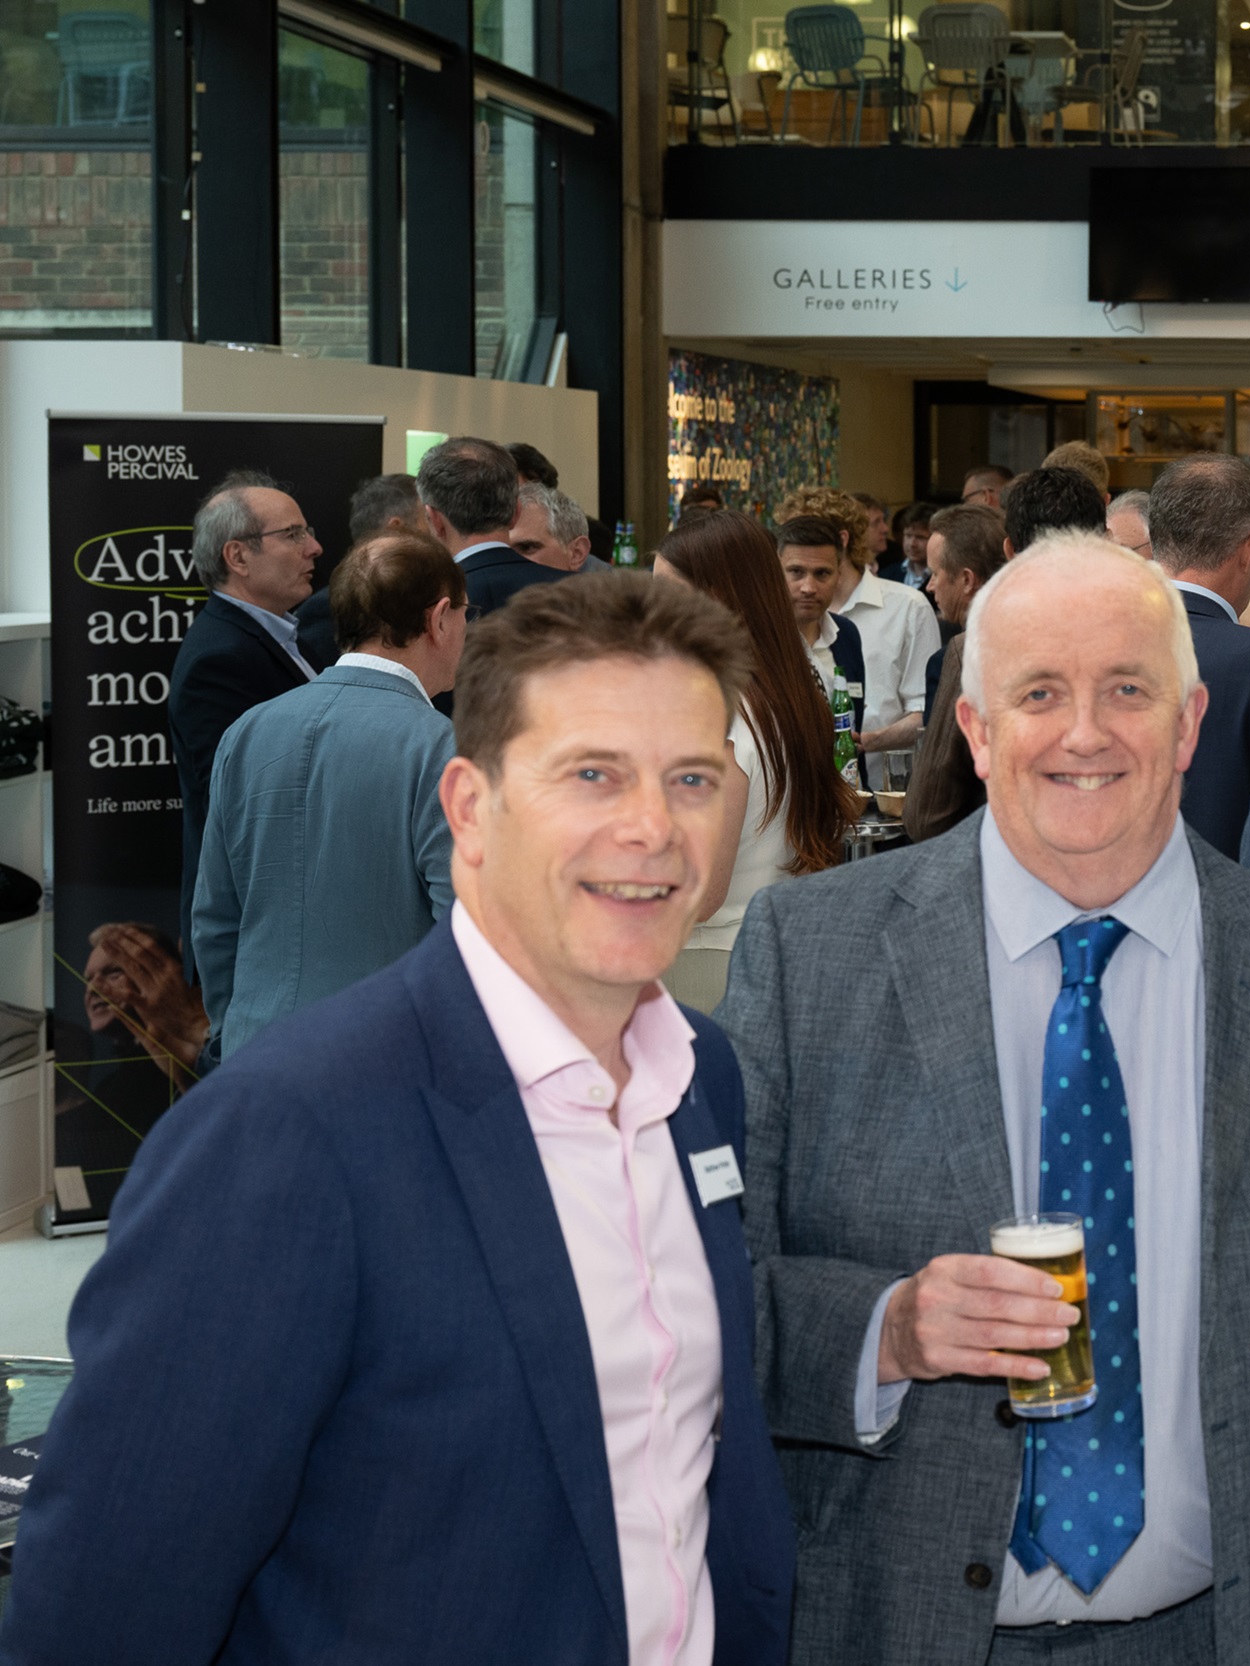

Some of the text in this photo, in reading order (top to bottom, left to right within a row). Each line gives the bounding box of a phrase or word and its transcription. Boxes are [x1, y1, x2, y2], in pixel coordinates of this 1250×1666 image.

[773, 268, 932, 289] GALLERIES
[805, 296, 899, 313] Free entry
[107, 444, 187, 462] HOWES
[108, 462, 200, 480] PERCIVAL
[88, 533, 195, 582] Adv
[88, 732, 177, 769] am
[87, 797, 118, 814] Life
[122, 799, 160, 812] more
